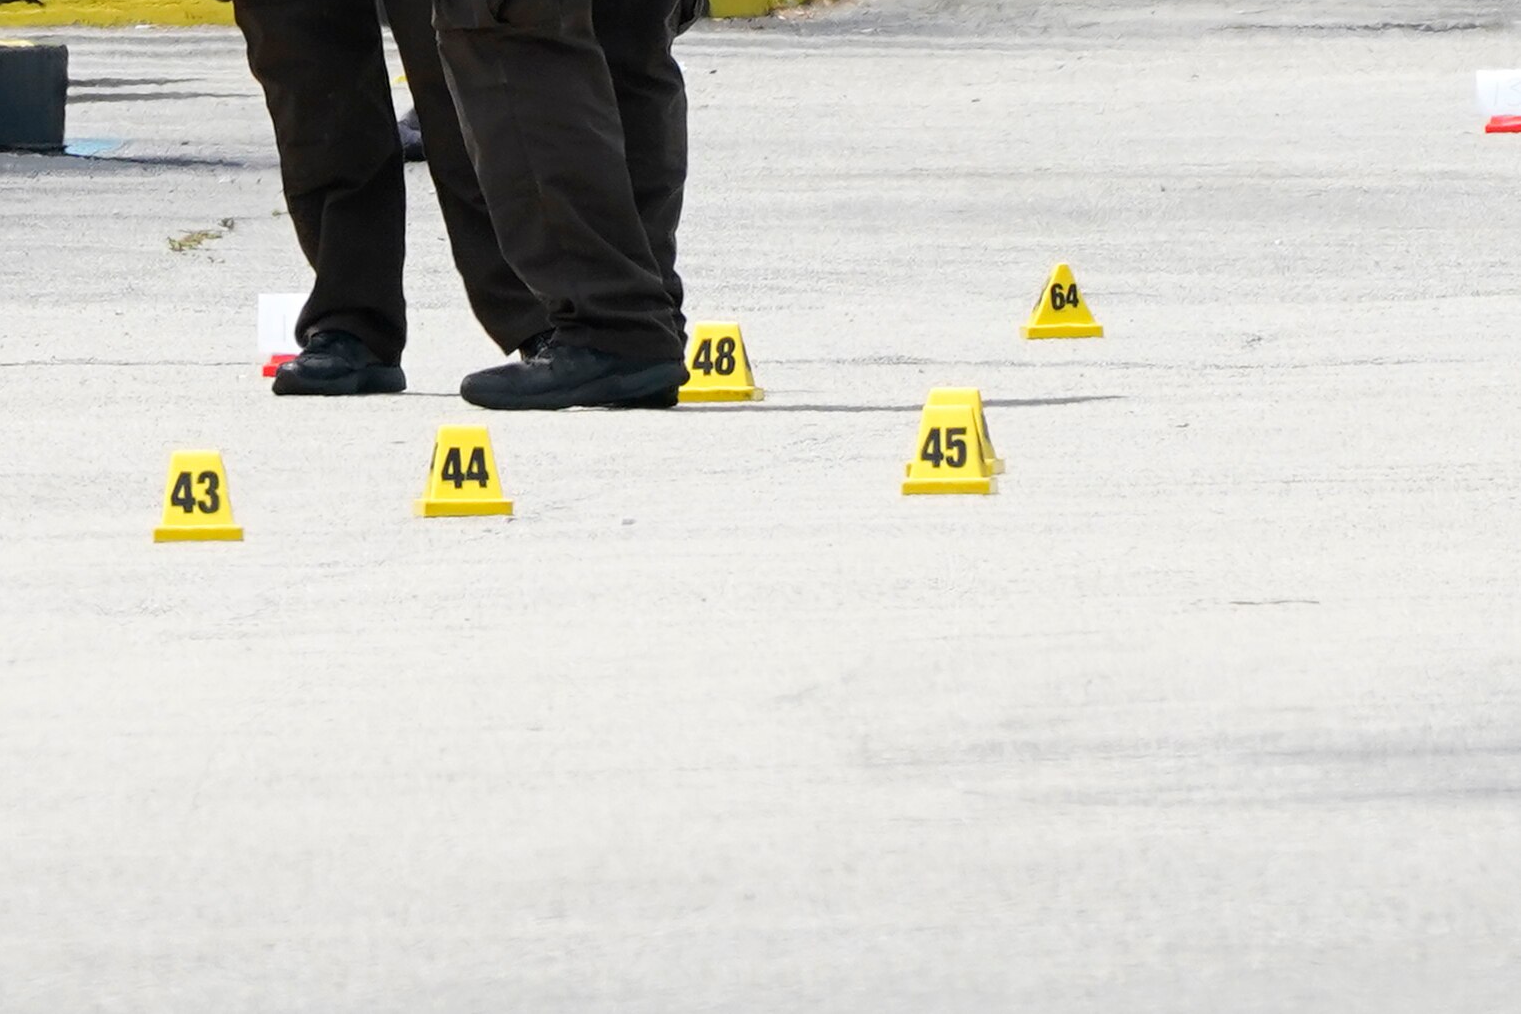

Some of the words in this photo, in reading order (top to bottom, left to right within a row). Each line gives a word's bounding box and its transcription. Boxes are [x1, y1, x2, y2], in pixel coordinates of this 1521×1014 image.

[1050, 283, 1079, 311] 64
[692, 336, 736, 376] 48
[441, 446, 489, 489] 44
[920, 426, 967, 469] 45
[170, 470, 220, 514] 43
